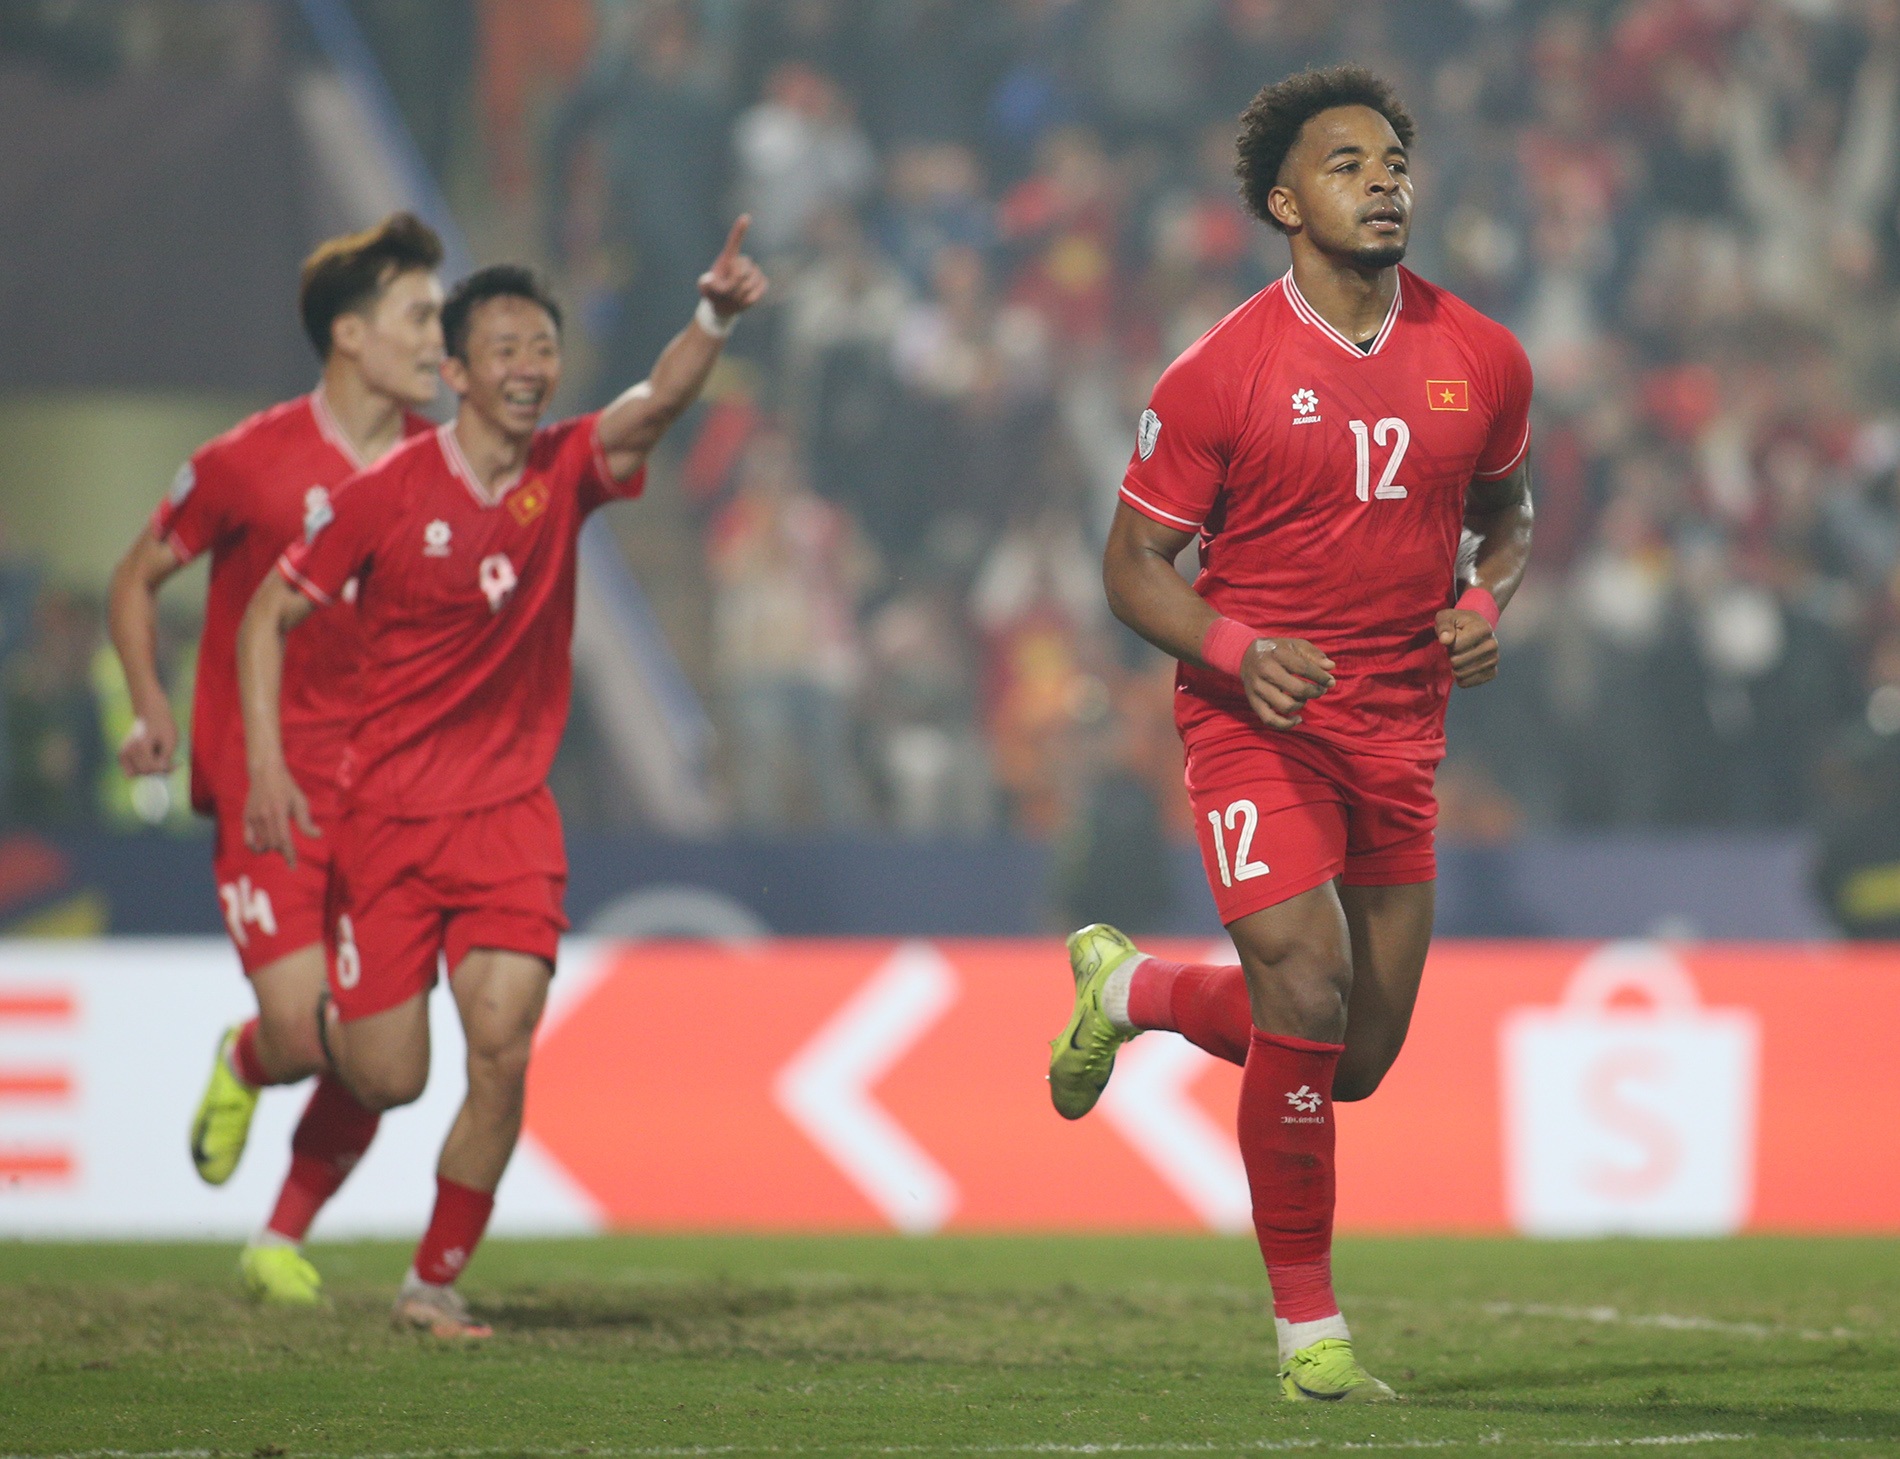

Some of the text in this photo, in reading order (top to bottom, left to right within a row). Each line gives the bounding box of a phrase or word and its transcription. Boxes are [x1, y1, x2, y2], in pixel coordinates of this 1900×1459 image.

[1348, 417, 1411, 502] 12
[1208, 799, 1270, 888] 12
[220, 874, 277, 947] 14
